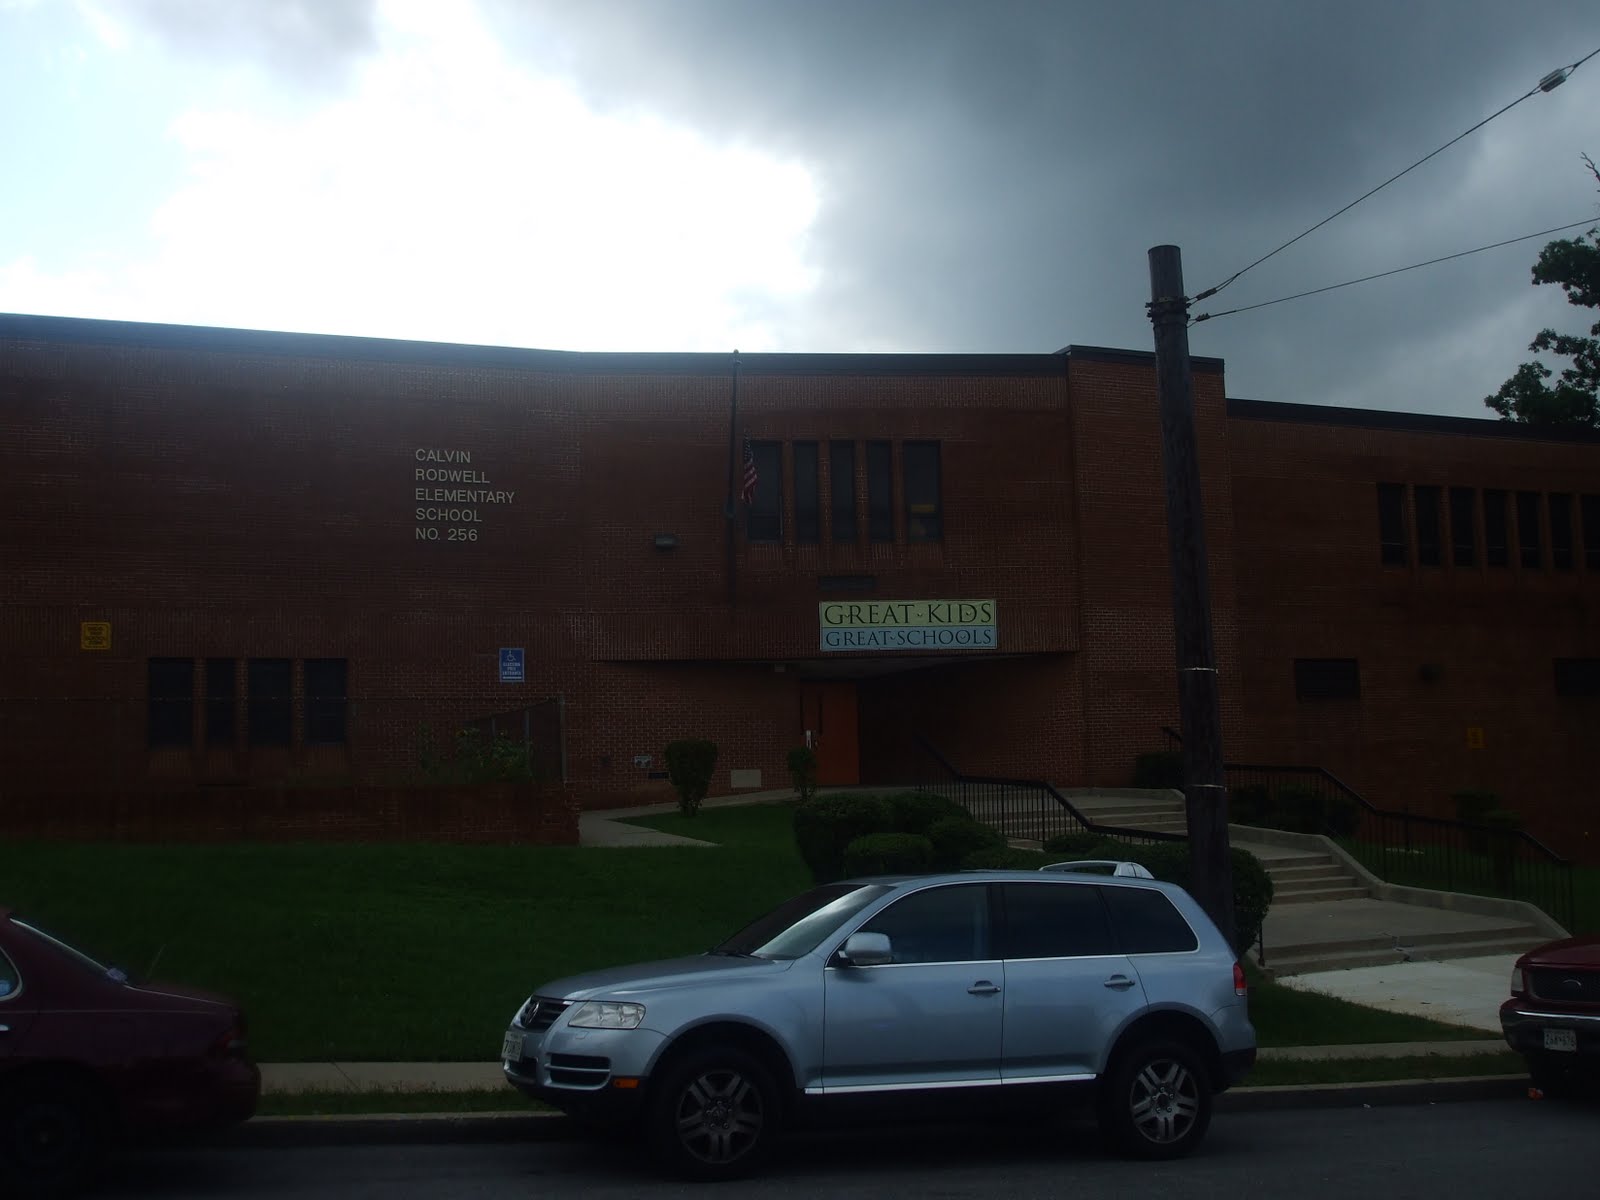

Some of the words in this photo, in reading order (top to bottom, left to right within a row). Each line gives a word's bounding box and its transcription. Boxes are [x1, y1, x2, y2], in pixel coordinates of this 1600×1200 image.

[415, 448, 471, 463] CALVIN
[415, 468, 491, 484] RODWELL
[415, 487, 515, 504] ELEMENTARY
[415, 507, 483, 522] SCHOOL
[415, 527, 441, 541] NO.
[447, 528, 478, 541] 256
[824, 604, 915, 625] GREAT
[928, 602, 992, 624] KIDS
[825, 630, 892, 647] GREAT
[897, 629, 992, 646] SCHOOLS
